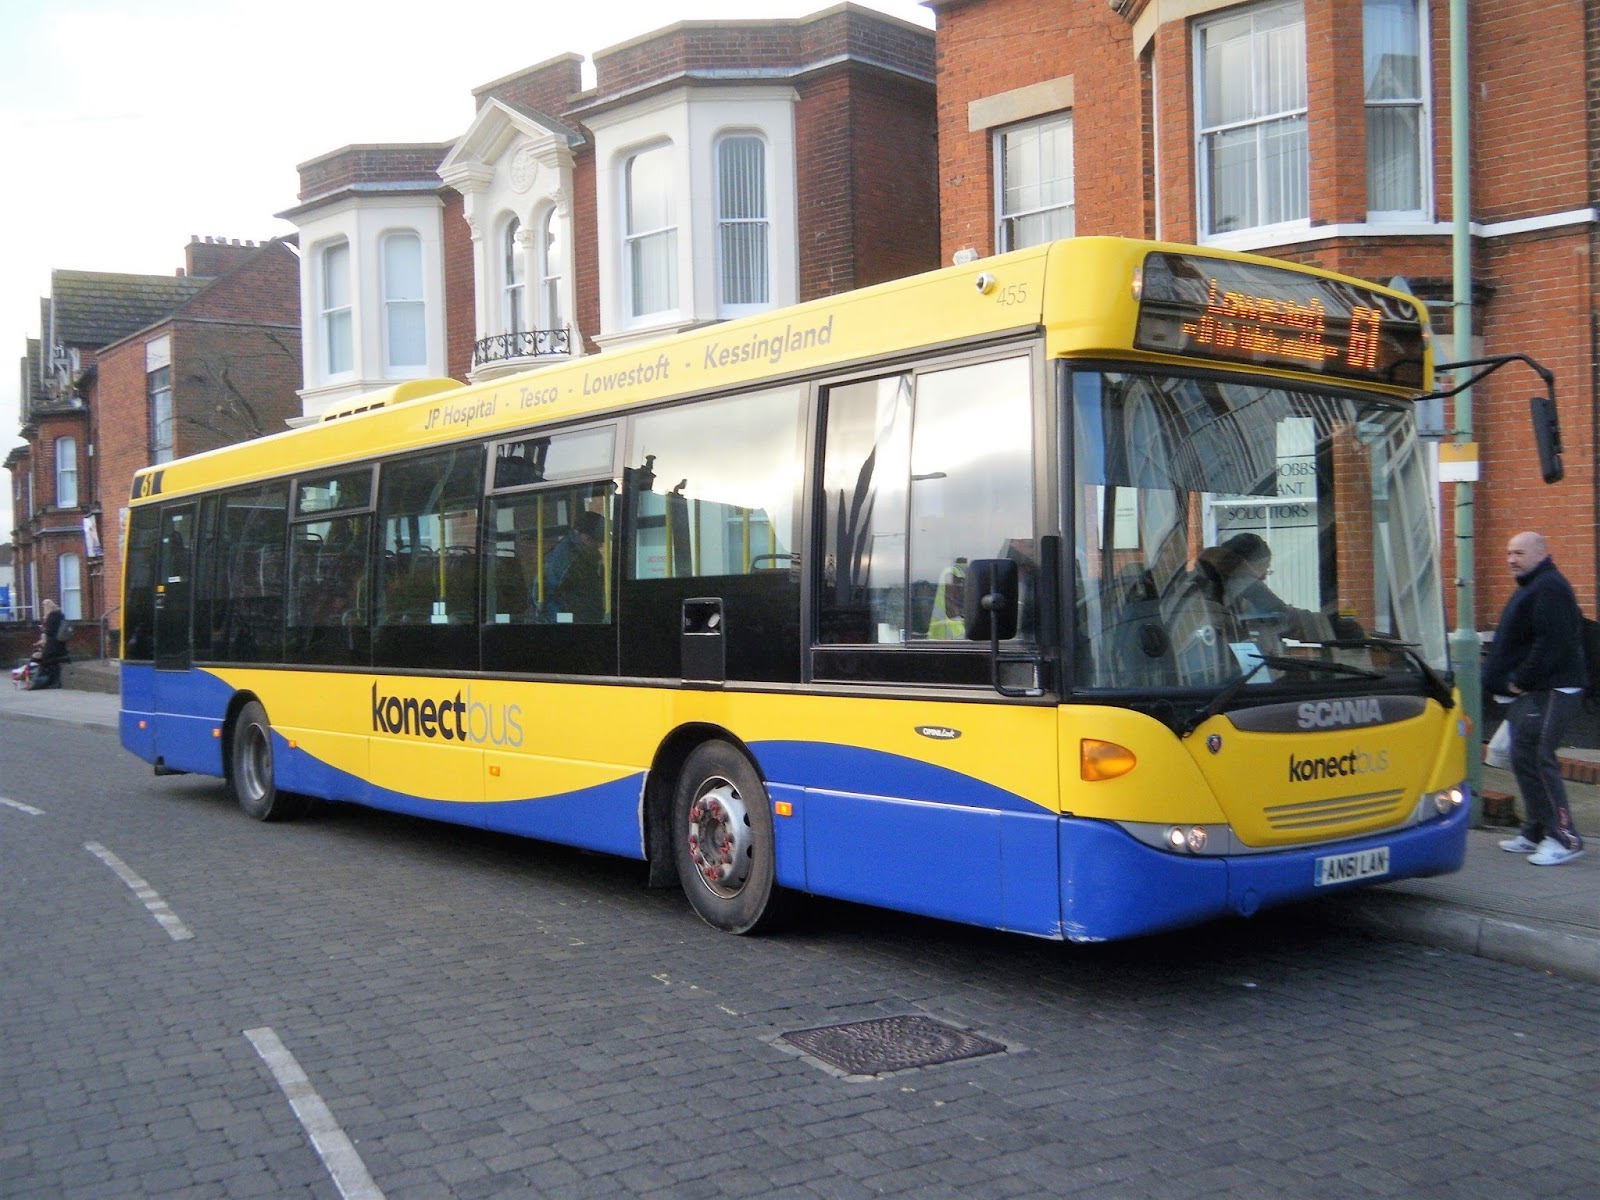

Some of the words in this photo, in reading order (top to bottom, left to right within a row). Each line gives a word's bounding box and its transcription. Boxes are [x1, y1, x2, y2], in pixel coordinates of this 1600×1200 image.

[996, 283, 1028, 306] 455
[1206, 278, 1325, 332] Lowestoft
[1347, 305, 1381, 368] 61
[424, 408, 441, 431] JP
[443, 394, 498, 427] Hospital
[520, 386, 559, 409] Tesco
[583, 353, 671, 396] Lowestoft
[703, 314, 835, 370] Kessingland
[1228, 505, 1309, 521] SOLICITORS
[371, 679, 524, 748] konectbus
[1297, 699, 1384, 729] SCANIA
[1289, 748, 1389, 782] konectbus
[1328, 855, 1359, 881] AN61
[1361, 848, 1386, 875] LAN
